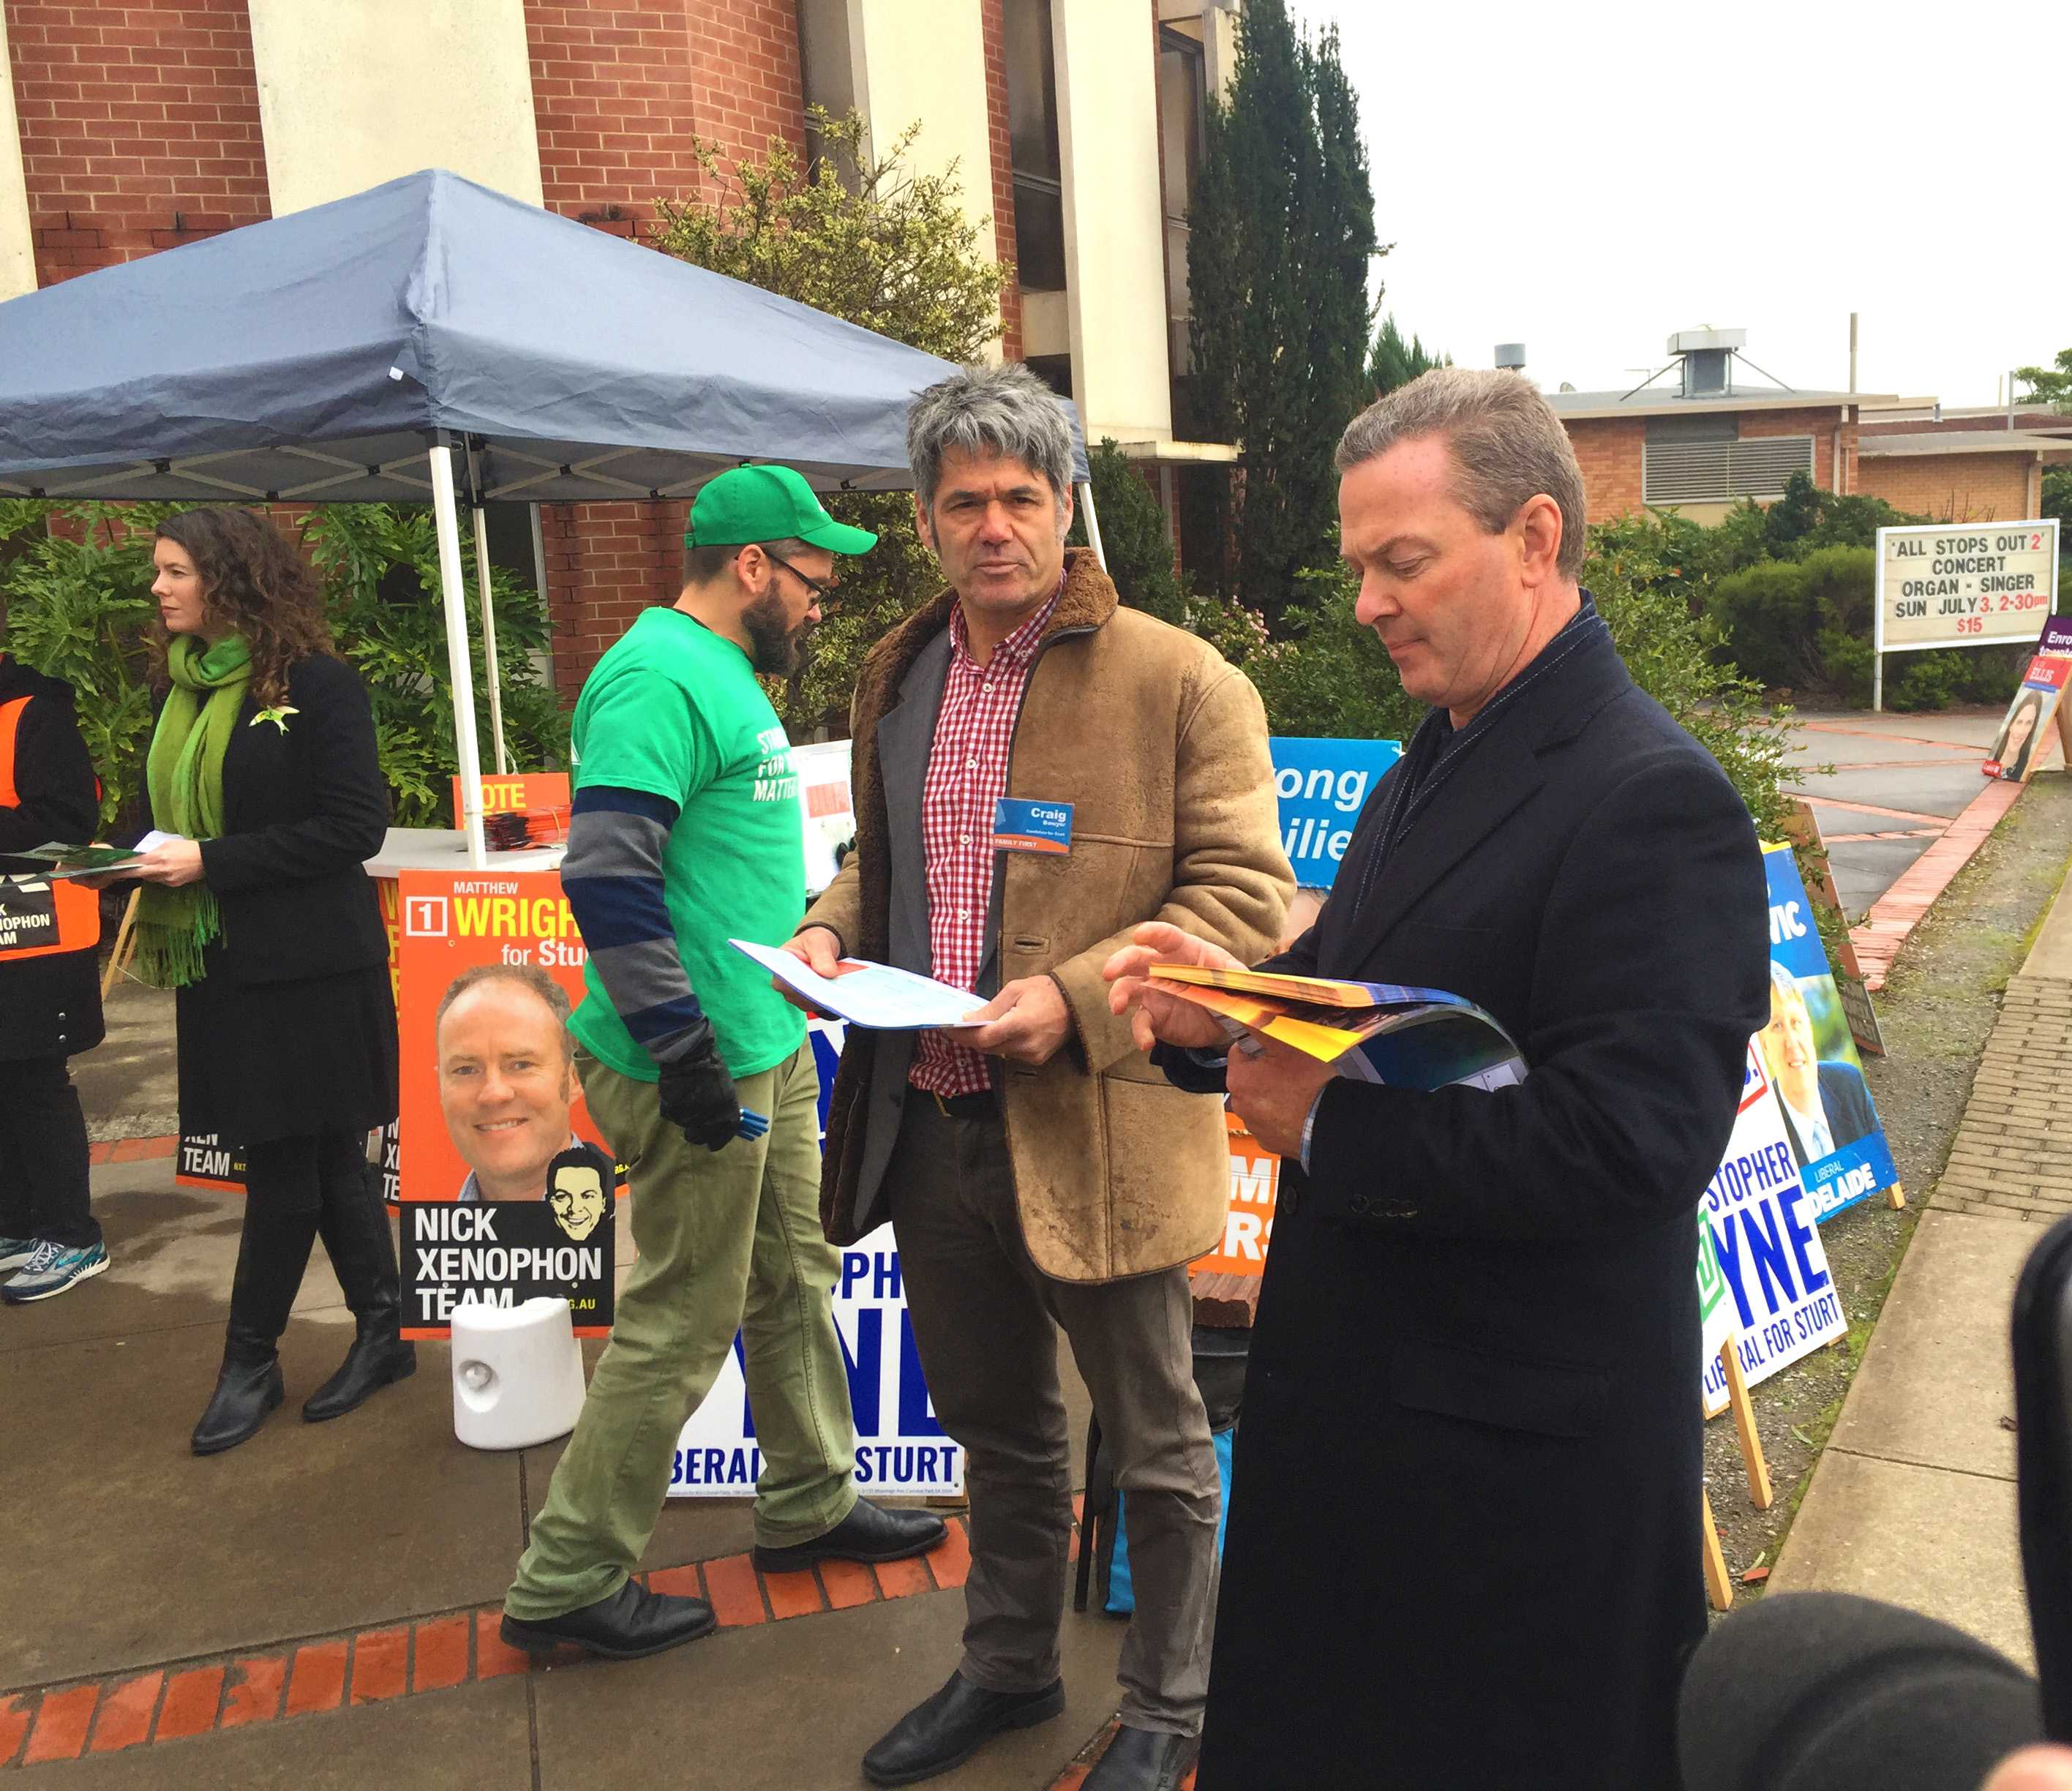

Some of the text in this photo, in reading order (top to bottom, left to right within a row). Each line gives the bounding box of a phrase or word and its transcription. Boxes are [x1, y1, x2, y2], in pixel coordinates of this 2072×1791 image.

[1936, 537, 1988, 555] STOPS
[1997, 535, 2027, 552] OUT
[1932, 556, 2006, 575] CONCERT
[1902, 579, 1959, 597] ORGAN
[1981, 574, 2035, 593] SINGER
[1896, 600, 1927, 617] SUN
[1939, 598, 1978, 615] JULY
[1957, 617, 1983, 634] $15
[1031, 807, 1067, 822] Craig
[454, 882, 518, 895] MATTHEW
[501, 945, 532, 966] for
[184, 1147, 230, 1176] TEAM
[1814, 1160, 1844, 1183] LIBERAL
[415, 1208, 498, 1242] NICK
[416, 1247, 601, 1281] XENOPHON
[1763, 1318, 1795, 1358] FOR
[1794, 1292, 1839, 1340] STURT
[855, 1446, 957, 1483] STURT
